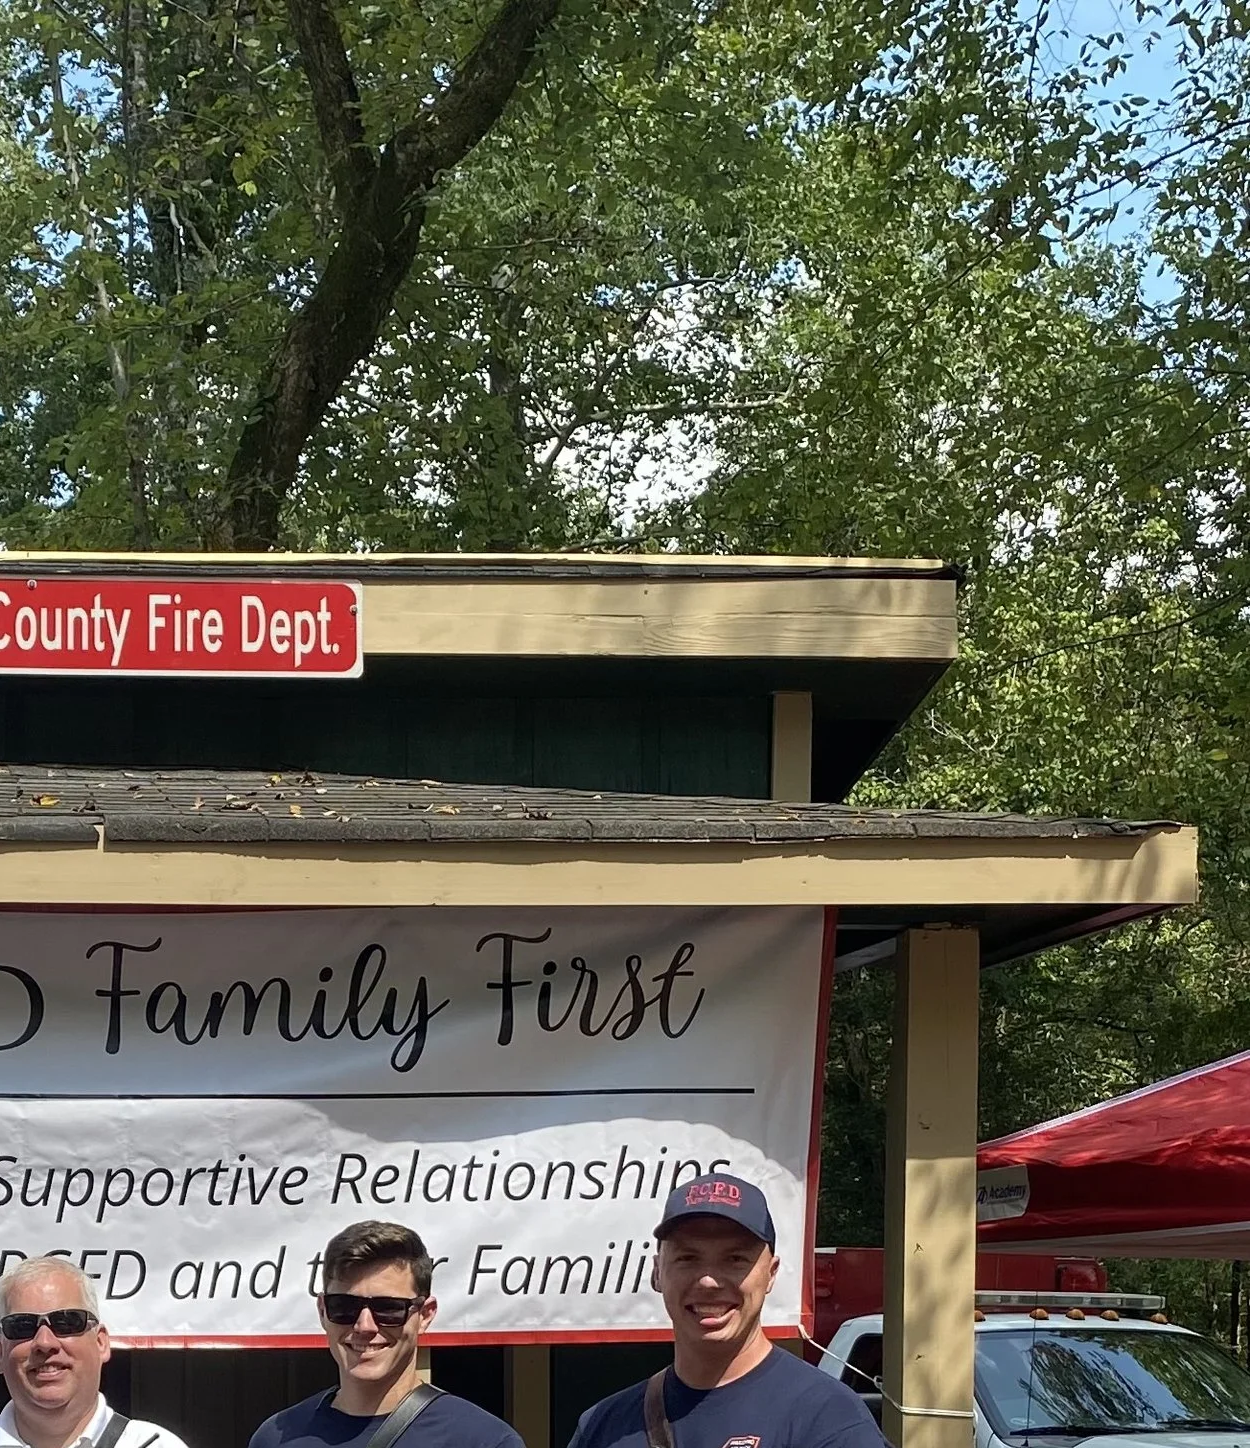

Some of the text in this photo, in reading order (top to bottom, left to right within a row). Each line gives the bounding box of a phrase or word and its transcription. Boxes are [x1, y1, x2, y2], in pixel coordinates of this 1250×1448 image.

[147, 594, 223, 652] Fire
[241, 596, 340, 668] Dept.
[85, 936, 449, 1073] Family
[476, 927, 705, 1047] First
[989, 1185, 1026, 1200] Academy
[169, 1246, 287, 1300] and
[468, 1240, 662, 1295] Famili
